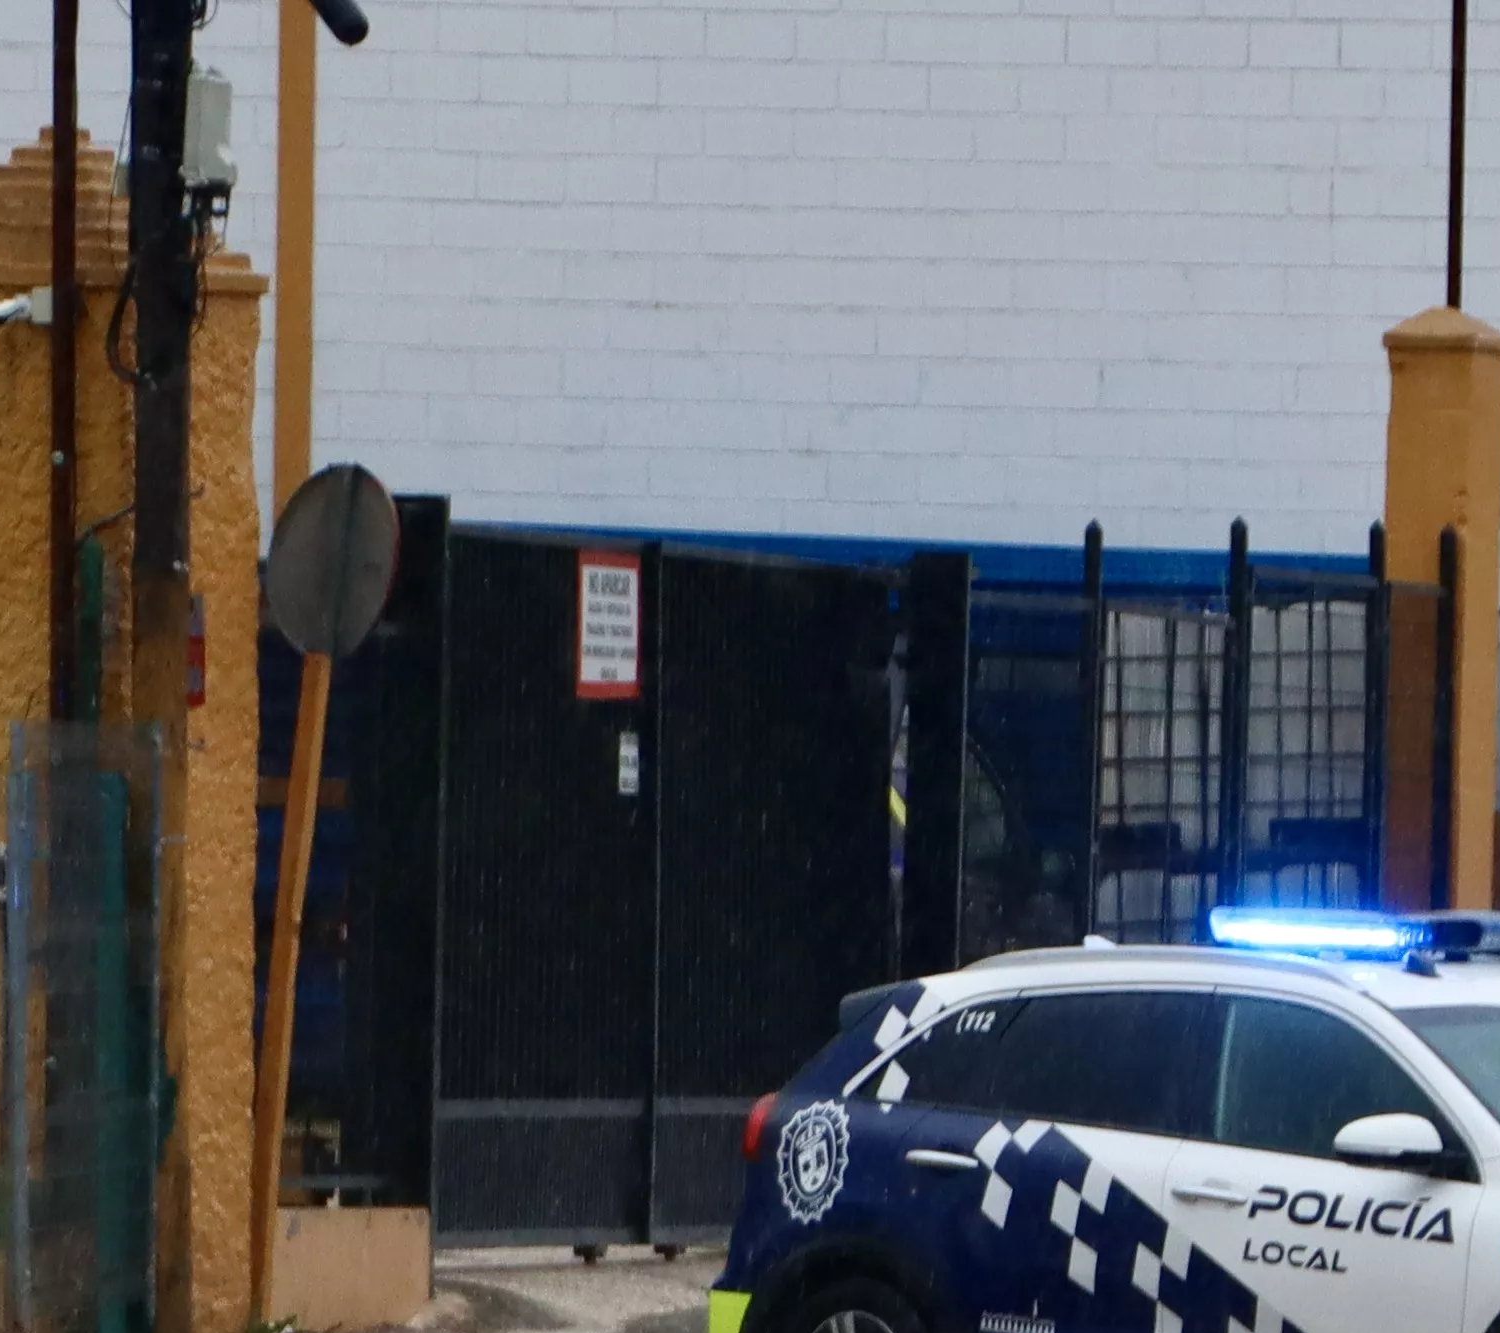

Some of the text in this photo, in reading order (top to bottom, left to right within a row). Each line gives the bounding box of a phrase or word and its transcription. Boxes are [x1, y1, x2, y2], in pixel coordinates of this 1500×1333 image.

[965, 1010, 996, 1032] 112
[1248, 1184, 1454, 1243] POLICÍA
[1242, 1238, 1348, 1273] LOCAL
